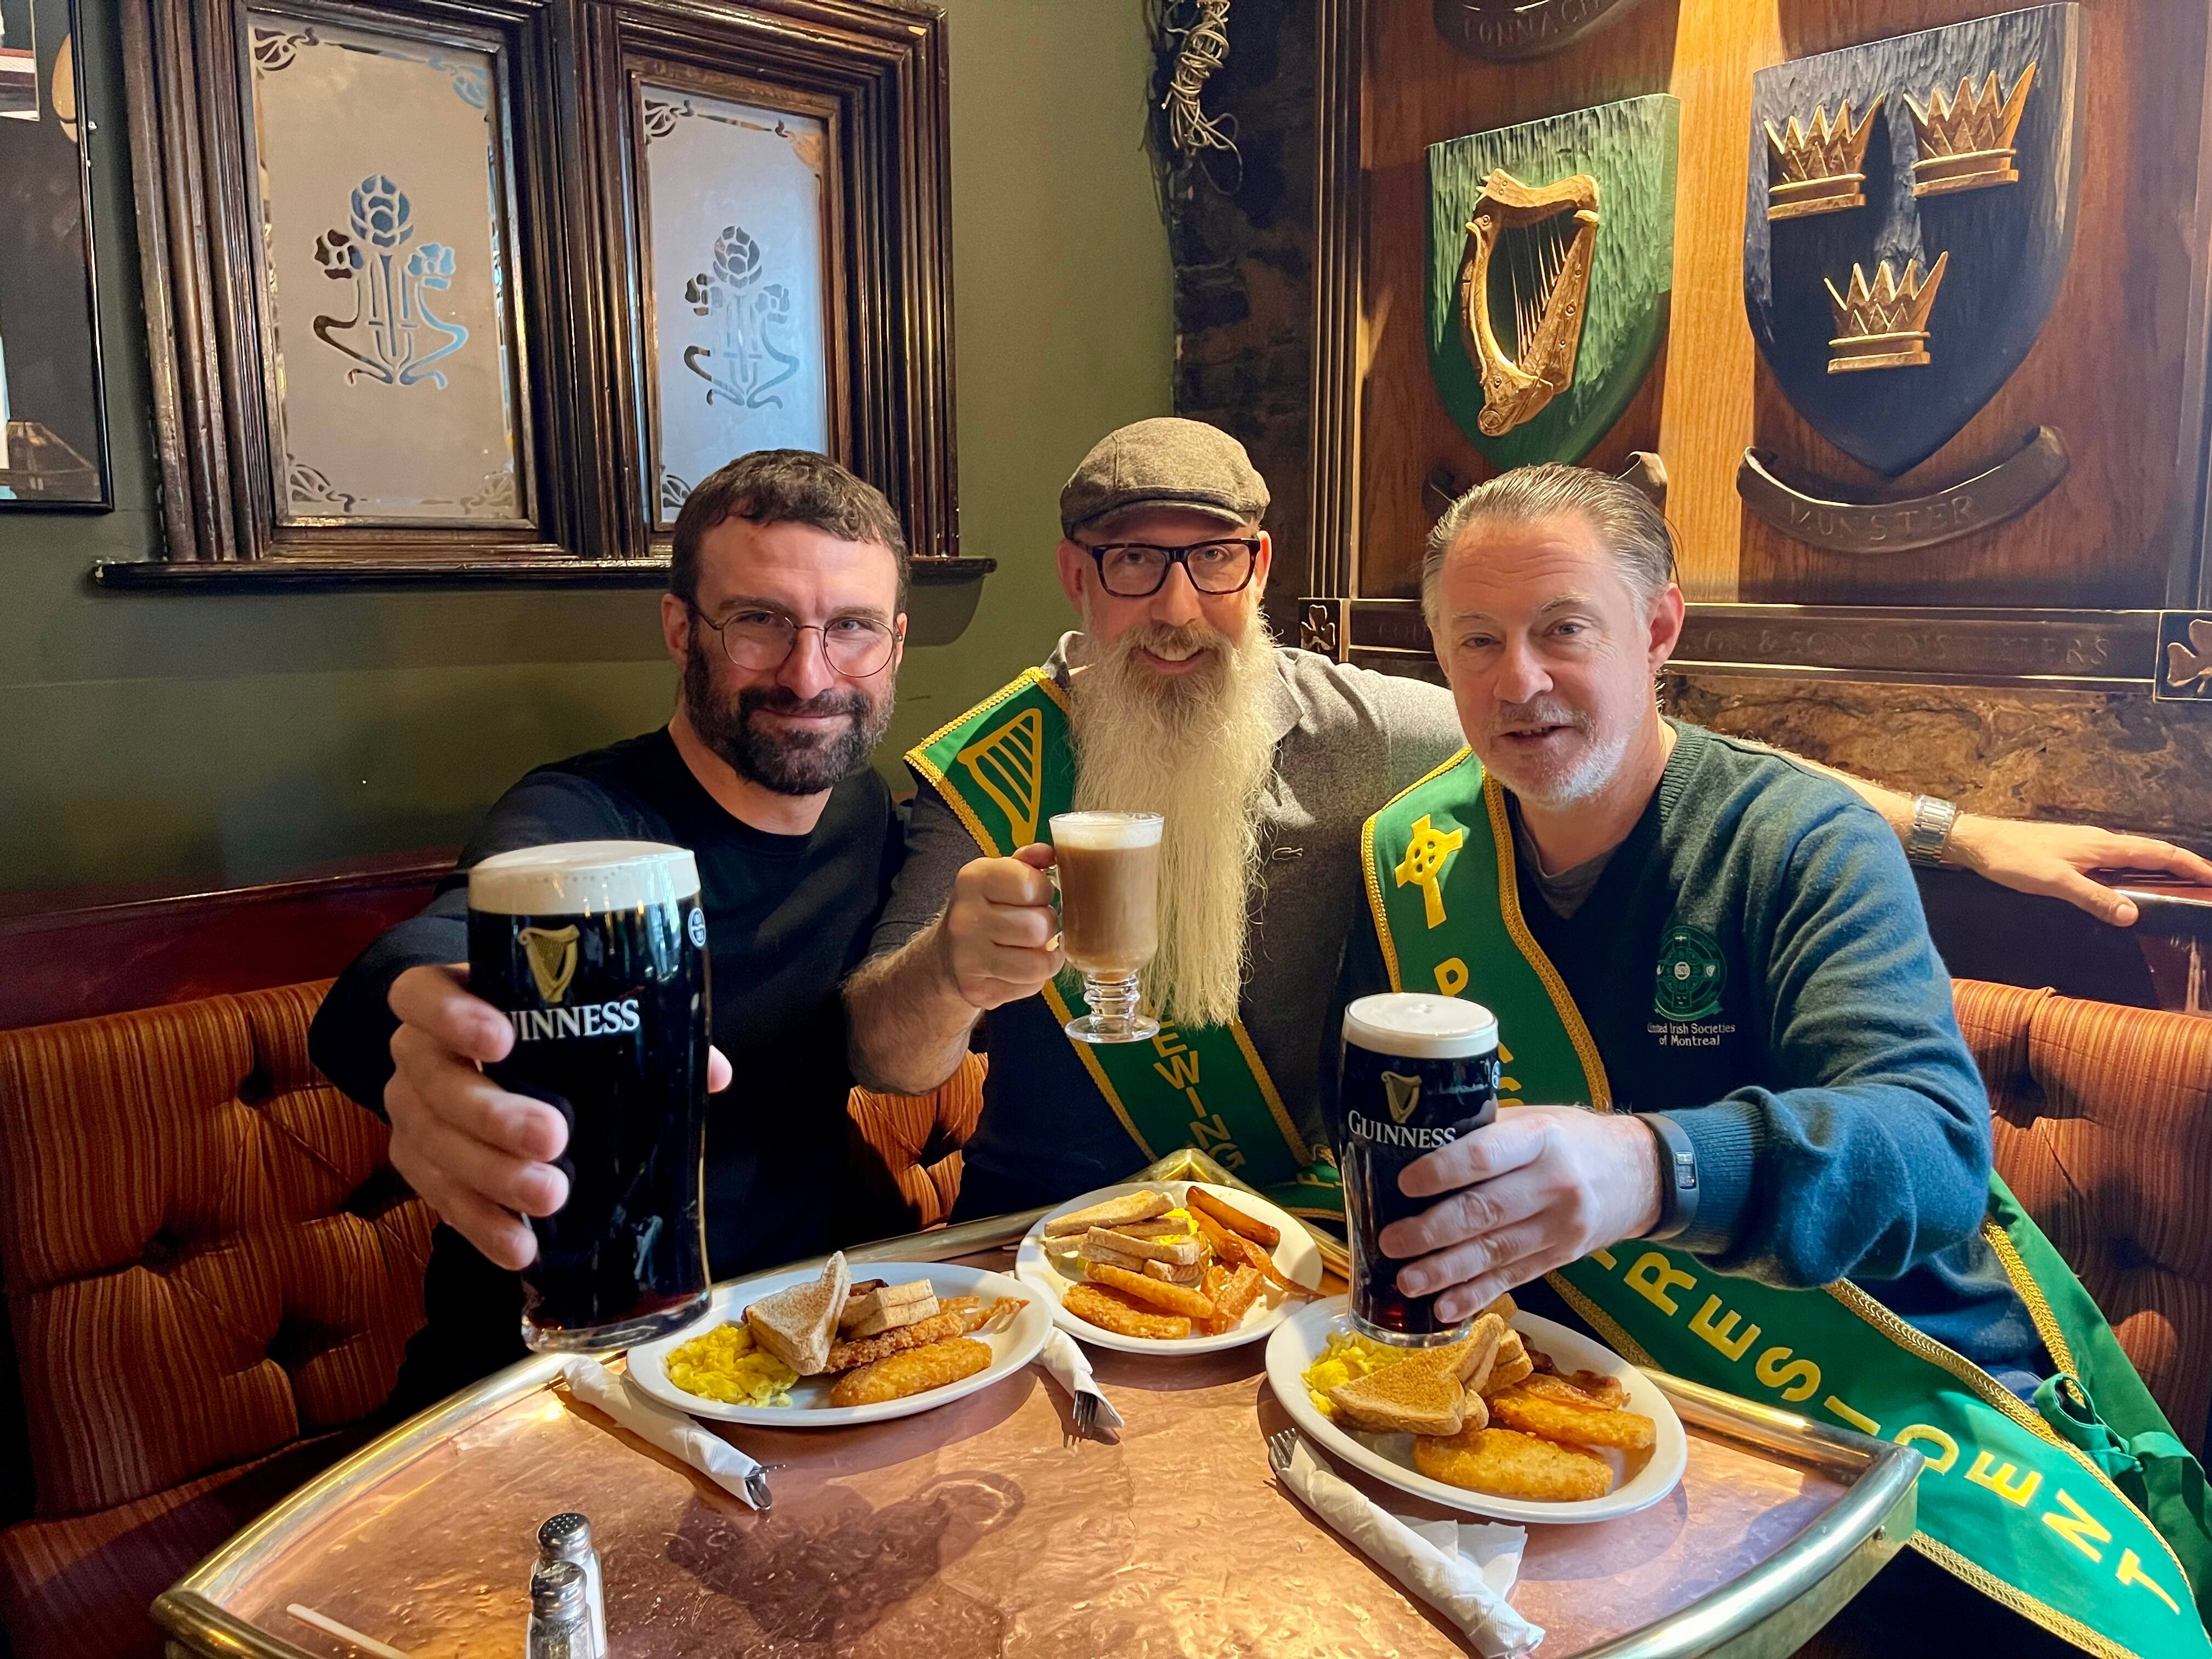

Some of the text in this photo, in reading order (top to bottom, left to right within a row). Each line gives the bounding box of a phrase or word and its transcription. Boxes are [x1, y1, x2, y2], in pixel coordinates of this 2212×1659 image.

[505, 998, 641, 1040] UINNESS
[1670, 1023, 1689, 1034] Irish
[1691, 1023, 1736, 1034] Societies
[1659, 1035, 1720, 1046] of Montreal
[1348, 1109, 1457, 1149] GUINNESS
[1589, 1248, 2181, 1615] RESIDENT
